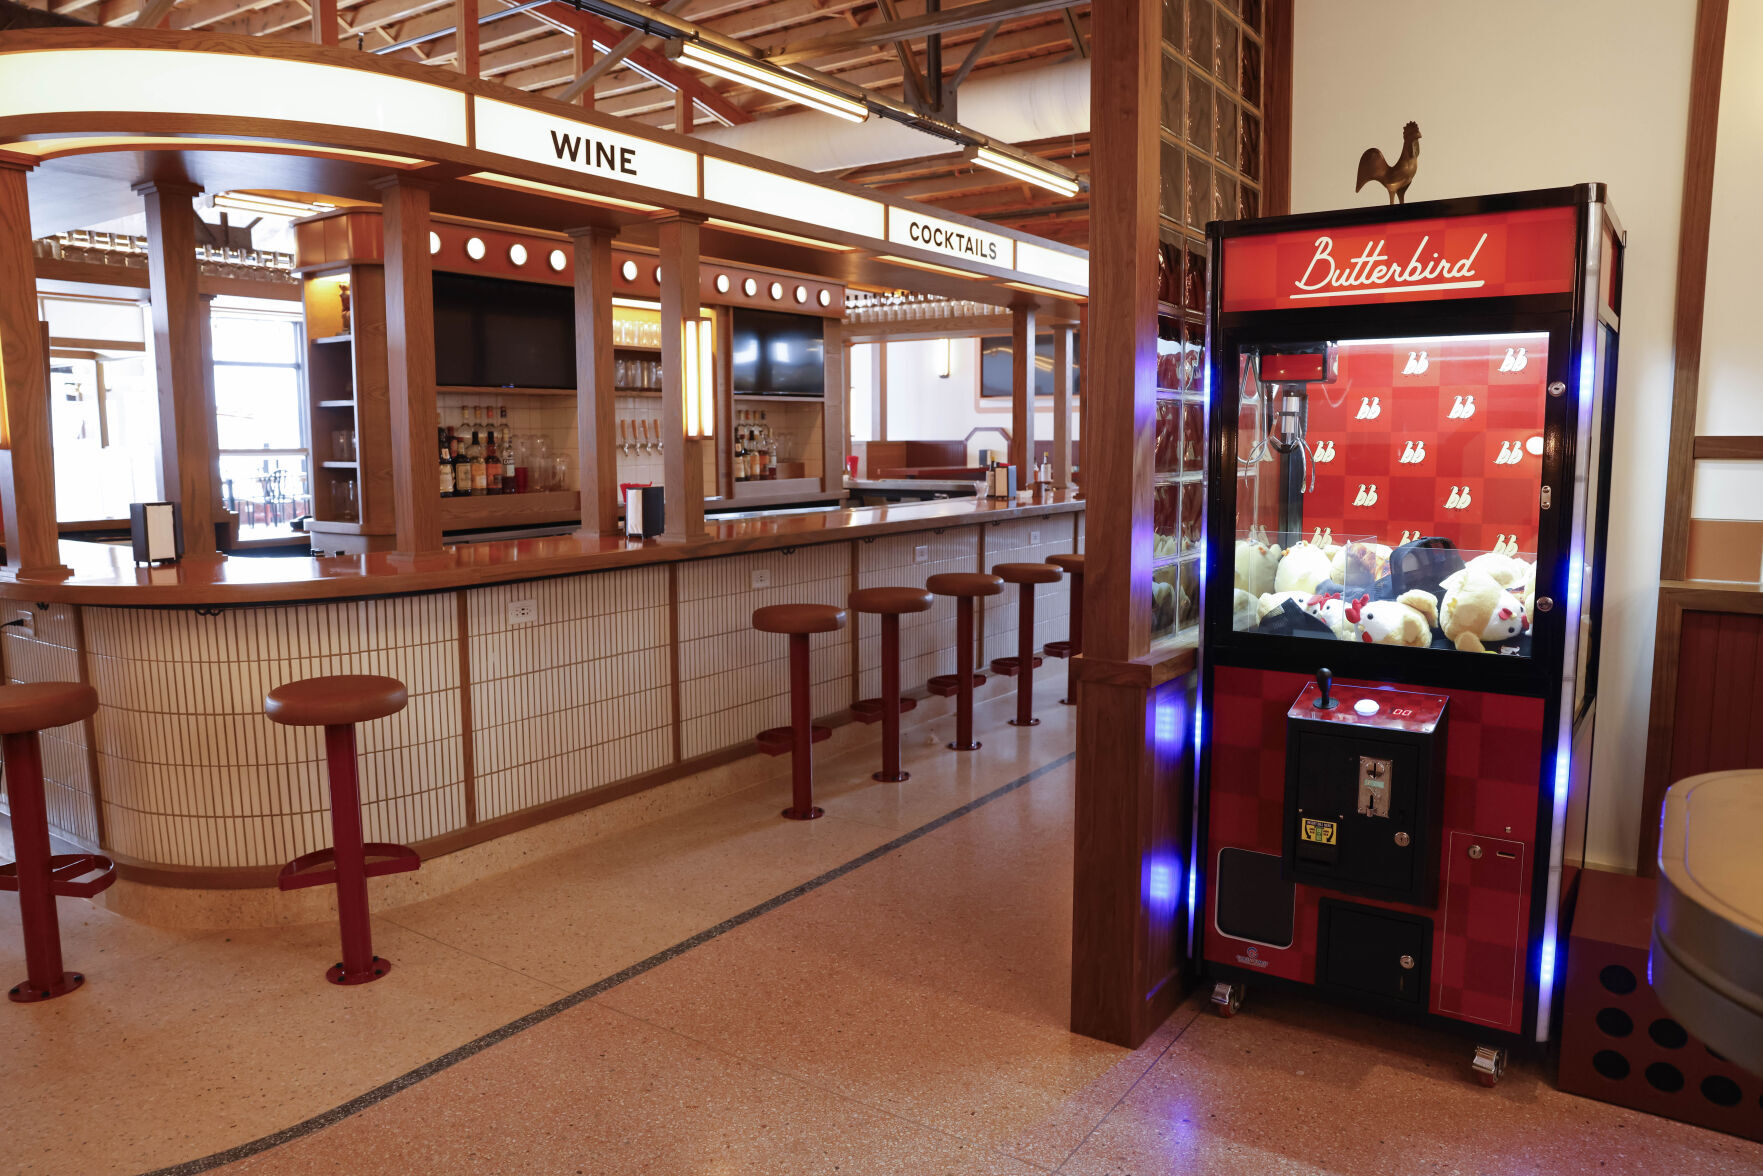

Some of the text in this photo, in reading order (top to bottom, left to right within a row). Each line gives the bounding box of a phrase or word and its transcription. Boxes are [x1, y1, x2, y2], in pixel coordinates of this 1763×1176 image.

[550, 130, 637, 176] WINE
[909, 221, 997, 260] COCKTAILS
[1294, 233, 1488, 291] Butterbird
